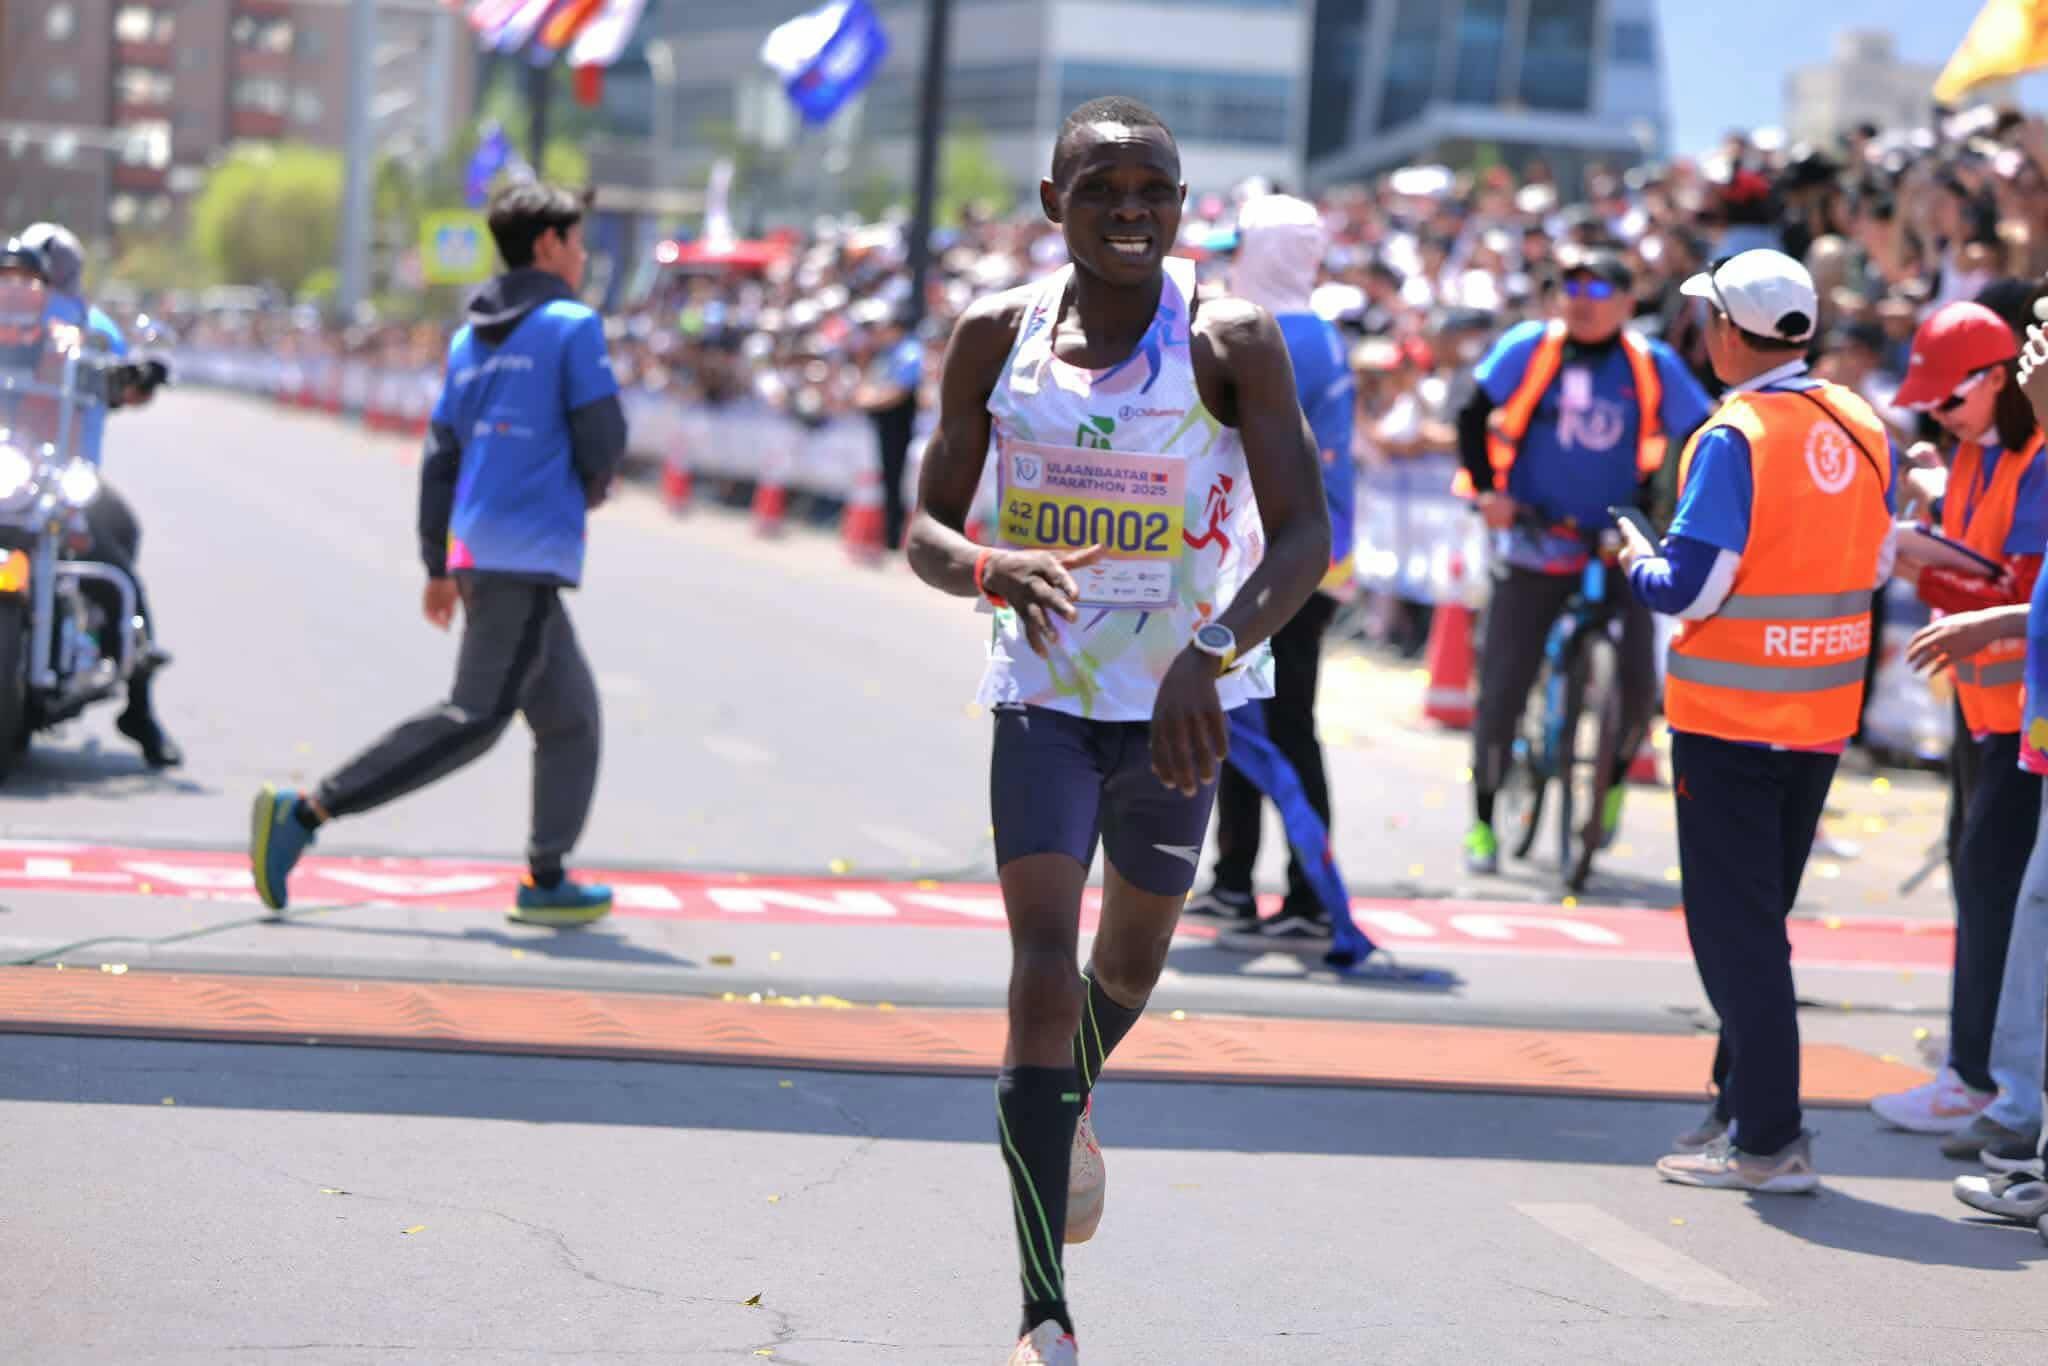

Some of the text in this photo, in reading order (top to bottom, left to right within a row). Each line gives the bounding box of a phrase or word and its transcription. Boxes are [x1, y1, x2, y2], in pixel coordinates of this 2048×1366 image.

[1046, 463, 1148, 481] ULAANBAATAR
[1046, 475, 1168, 496] MARATHON 2025
[1008, 500, 1032, 519] 42
[1036, 501, 1169, 551] 00002
